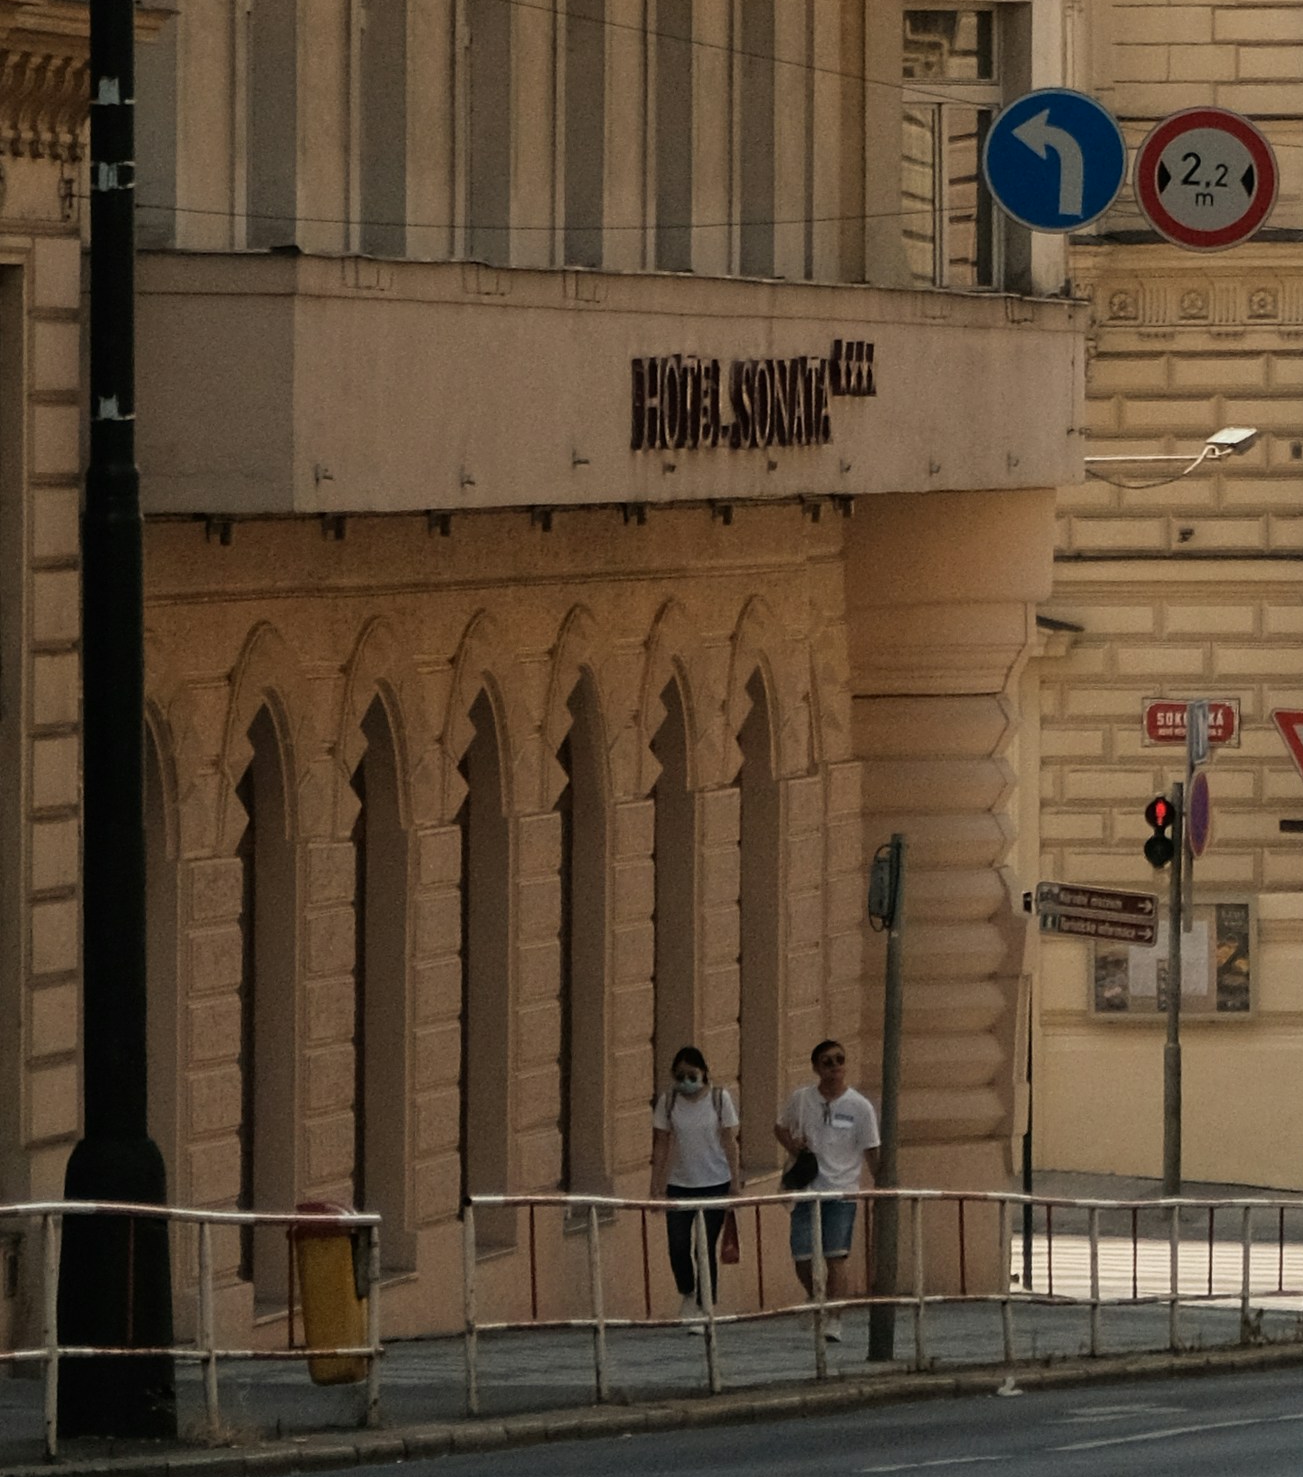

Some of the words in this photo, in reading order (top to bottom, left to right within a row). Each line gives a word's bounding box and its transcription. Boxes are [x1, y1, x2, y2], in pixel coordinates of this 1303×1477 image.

[1181, 152, 1229, 188] 2,2
[1195, 192, 1214, 206] m
[631, 353, 730, 450] HOTEL
[730, 355, 833, 450] SONATA
